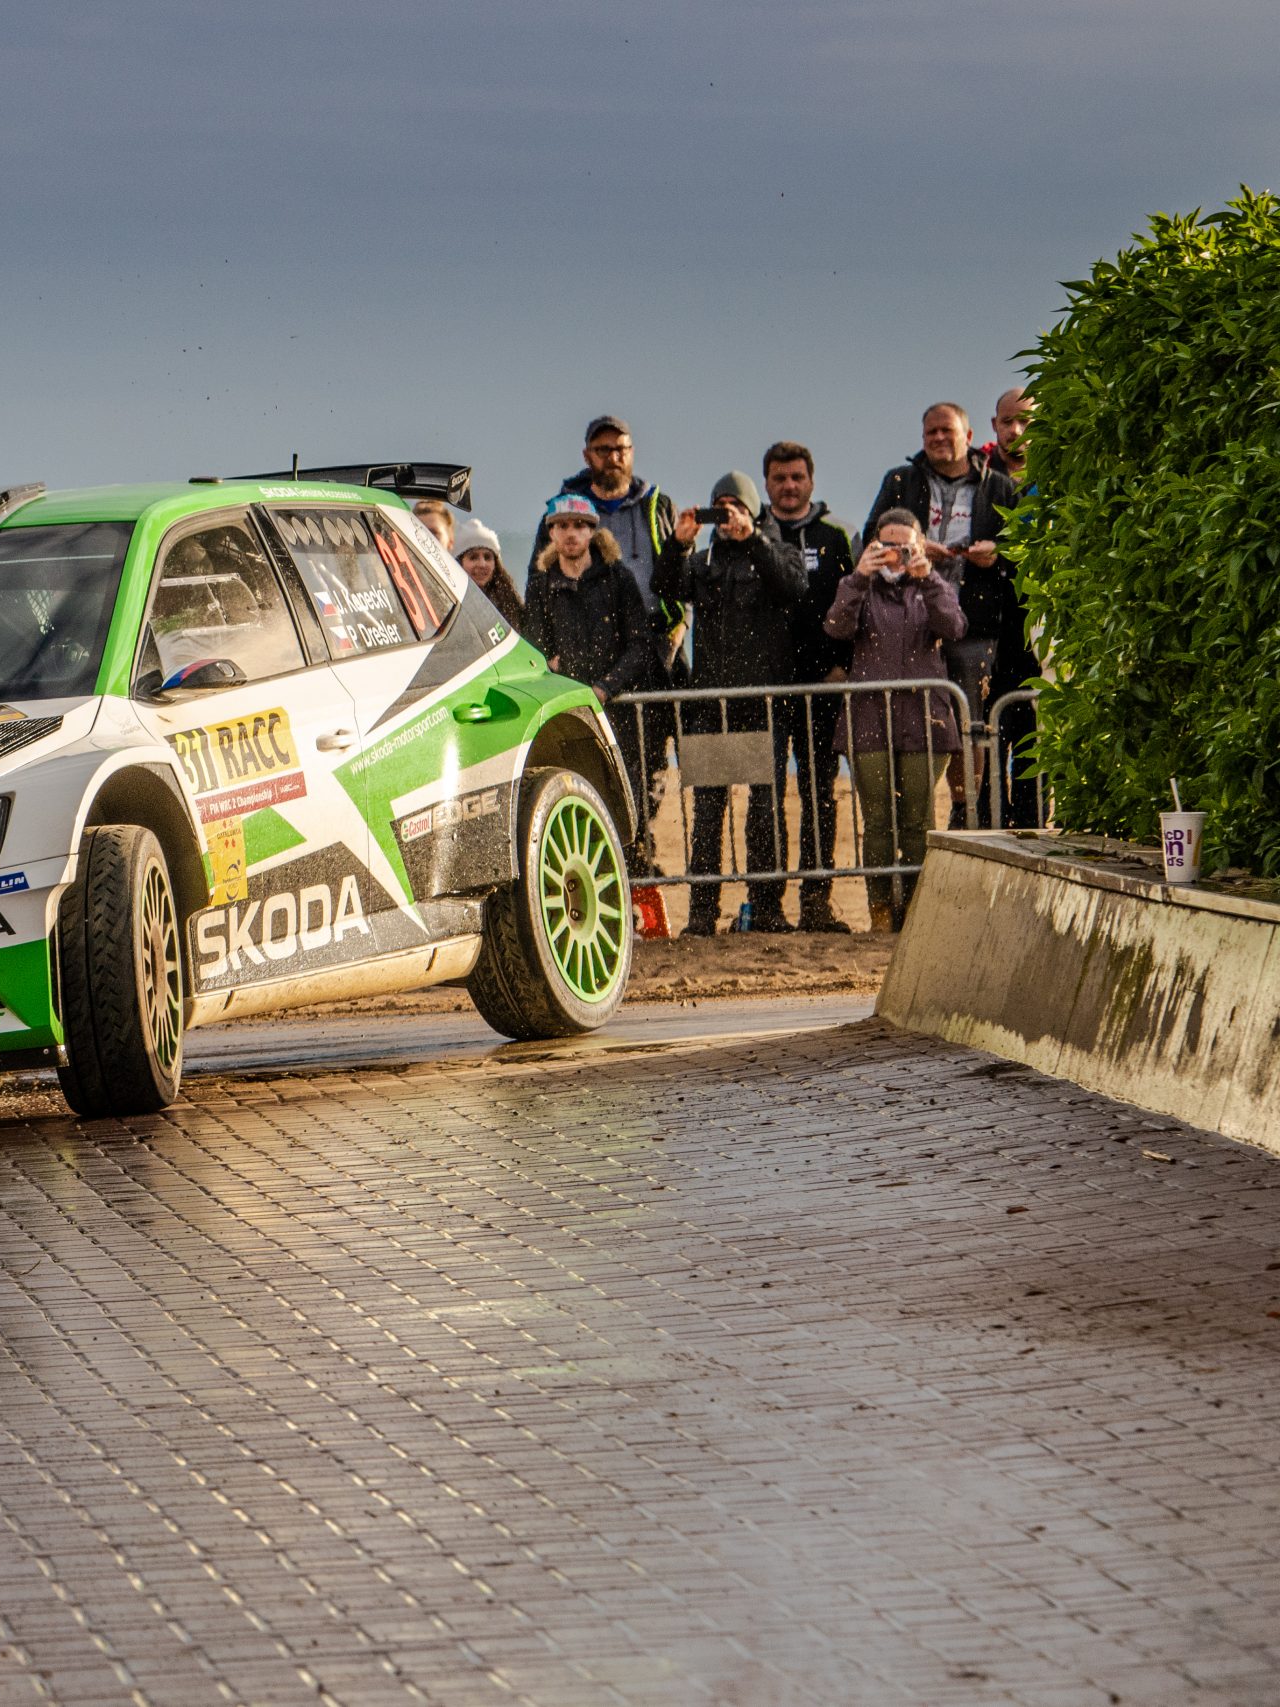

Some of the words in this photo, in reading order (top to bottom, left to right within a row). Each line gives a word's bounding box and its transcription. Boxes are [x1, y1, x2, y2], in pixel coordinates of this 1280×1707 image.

[375, 531, 441, 631] 31
[357, 620, 401, 647] Dresler
[488, 621, 506, 645] R5
[175, 730, 212, 794] 31
[216, 713, 291, 779] RACC
[350, 706, 450, 776] www.skoda-motorsport.com
[408, 814, 431, 836] Castrol
[1164, 829, 1184, 841] cD
